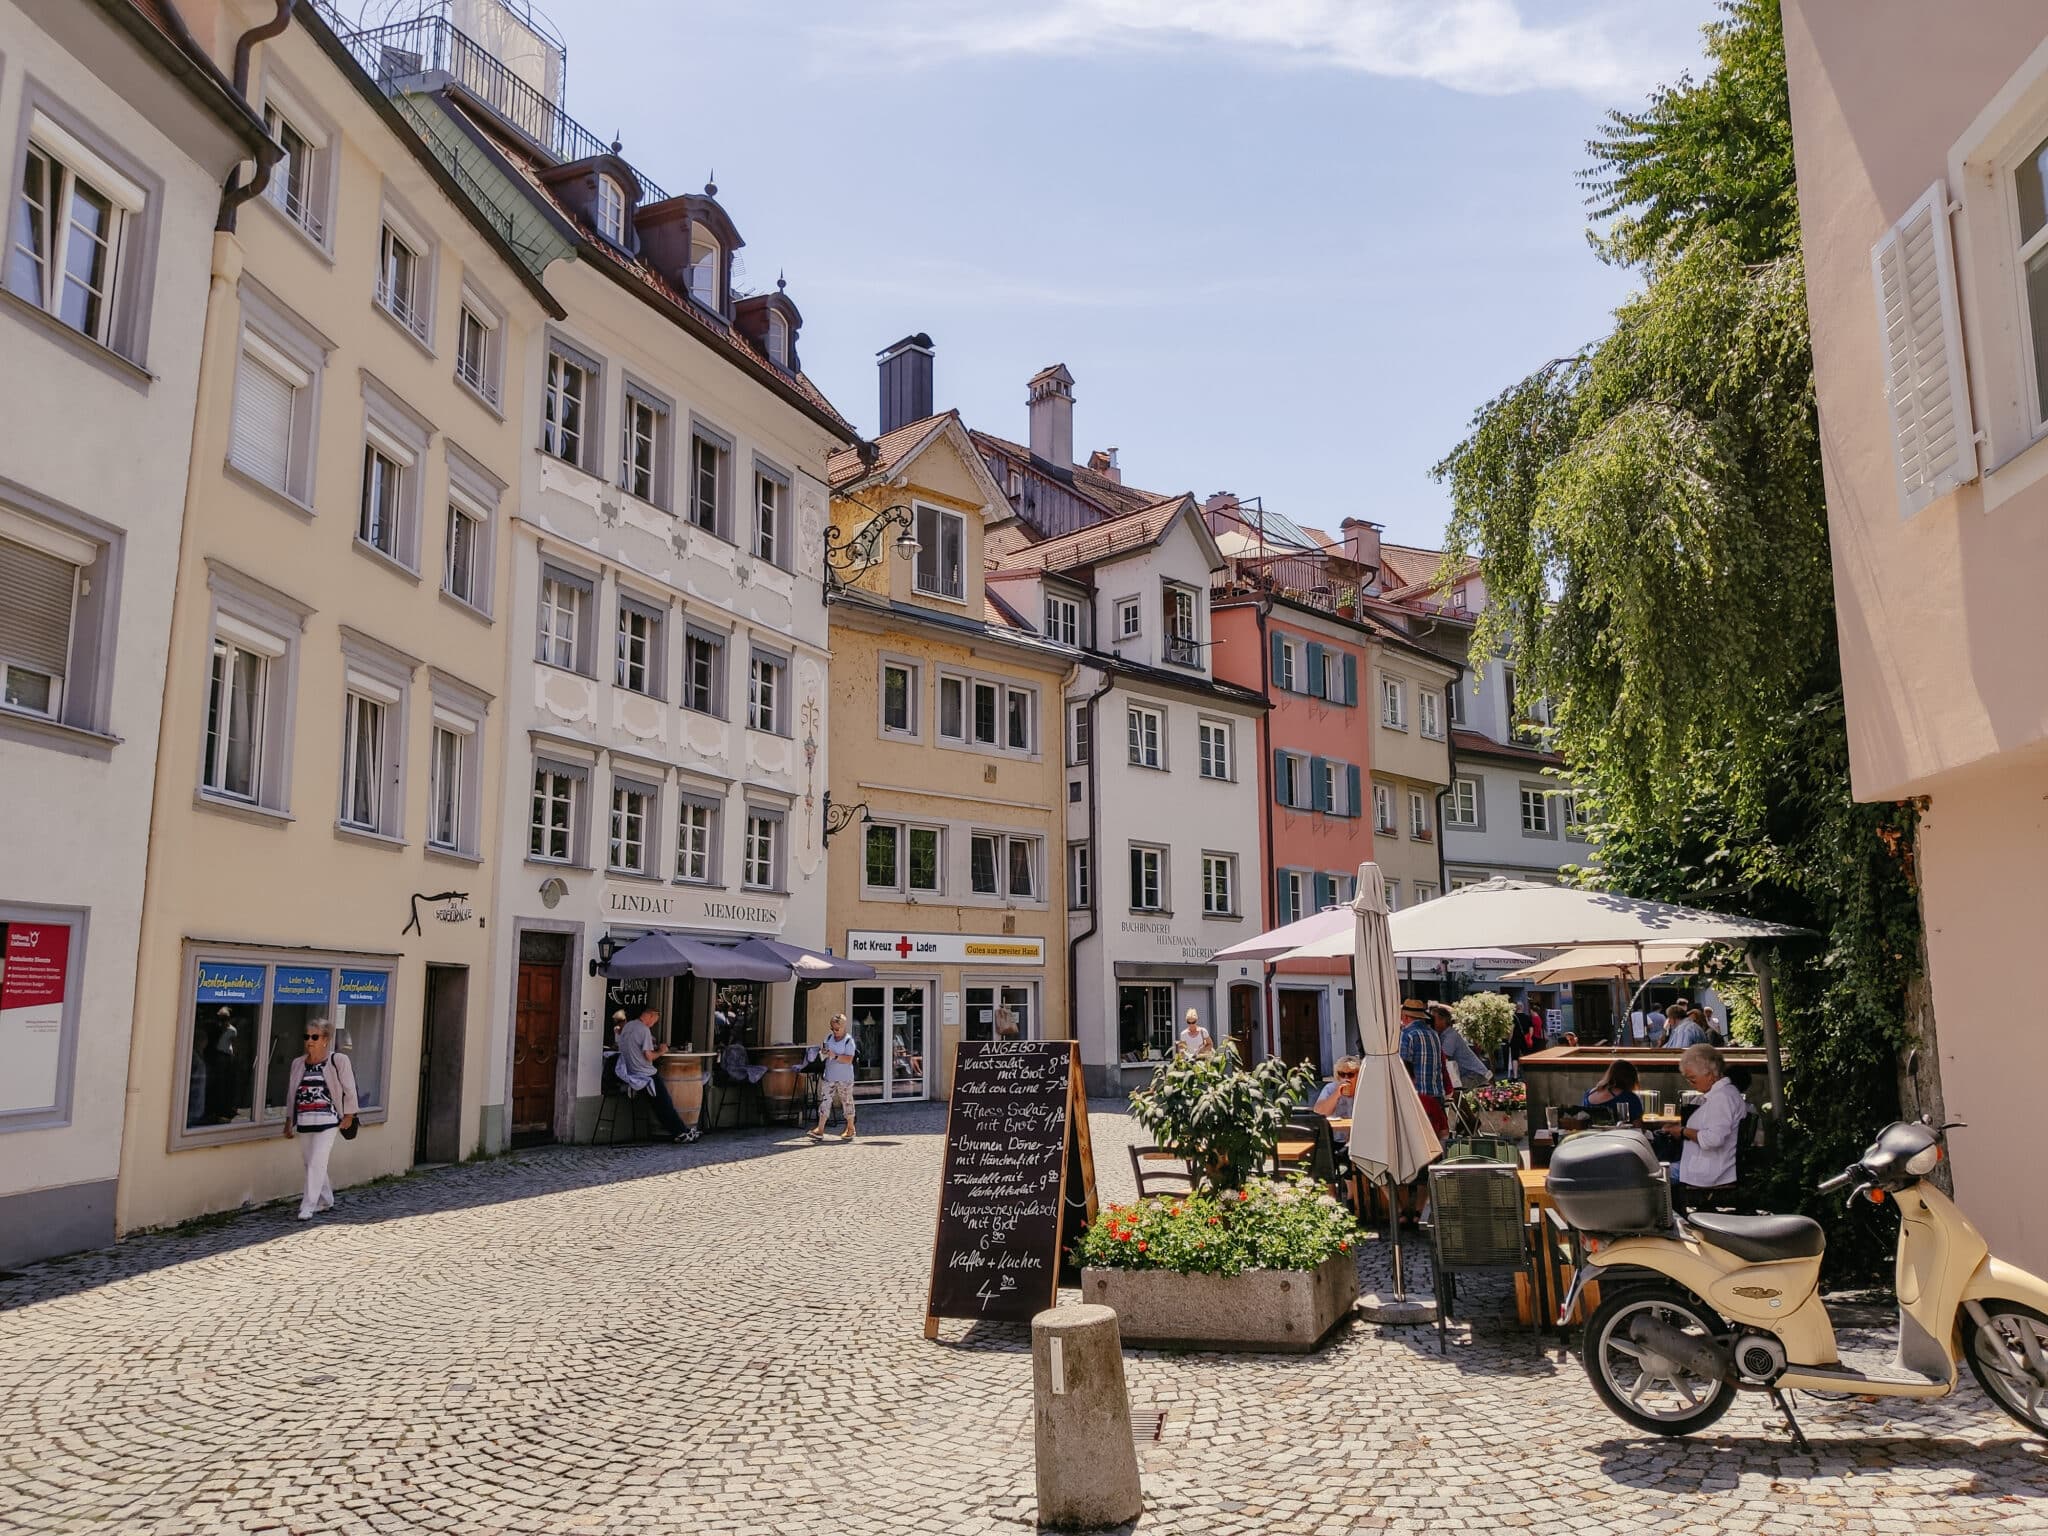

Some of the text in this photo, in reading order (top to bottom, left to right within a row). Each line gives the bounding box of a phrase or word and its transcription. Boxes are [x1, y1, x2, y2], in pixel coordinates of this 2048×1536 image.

[611, 893, 777, 923] LINDAU MEMORIES
[1121, 921, 1170, 934] BUCHBINDEREI
[853, 939, 937, 953] Rot Kreuz Laden
[966, 945, 986, 954] Gutes
[999, 947, 1021, 955] zweiter
[1022, 947, 1038, 956] Hand
[979, 1042, 1051, 1054] ANGEBOT
[997, 1064, 1046, 1081] mit Brot
[989, 1085, 1007, 1094] con
[1009, 1083, 1040, 1094] Carne
[1007, 1101, 1049, 1118] Salat
[975, 1118, 1001, 1131] mit
[1004, 1116, 1038, 1133] Brot
[958, 1134, 1003, 1151] Brunnen
[1008, 1137, 1045, 1151] Döner
[955, 1153, 976, 1166] mit
[1002, 1171, 1025, 1182] mit
[967, 1216, 1018, 1231] mit Brot
[949, 1249, 986, 1273] Kaffee
[997, 1250, 1043, 1269] Kuchen
